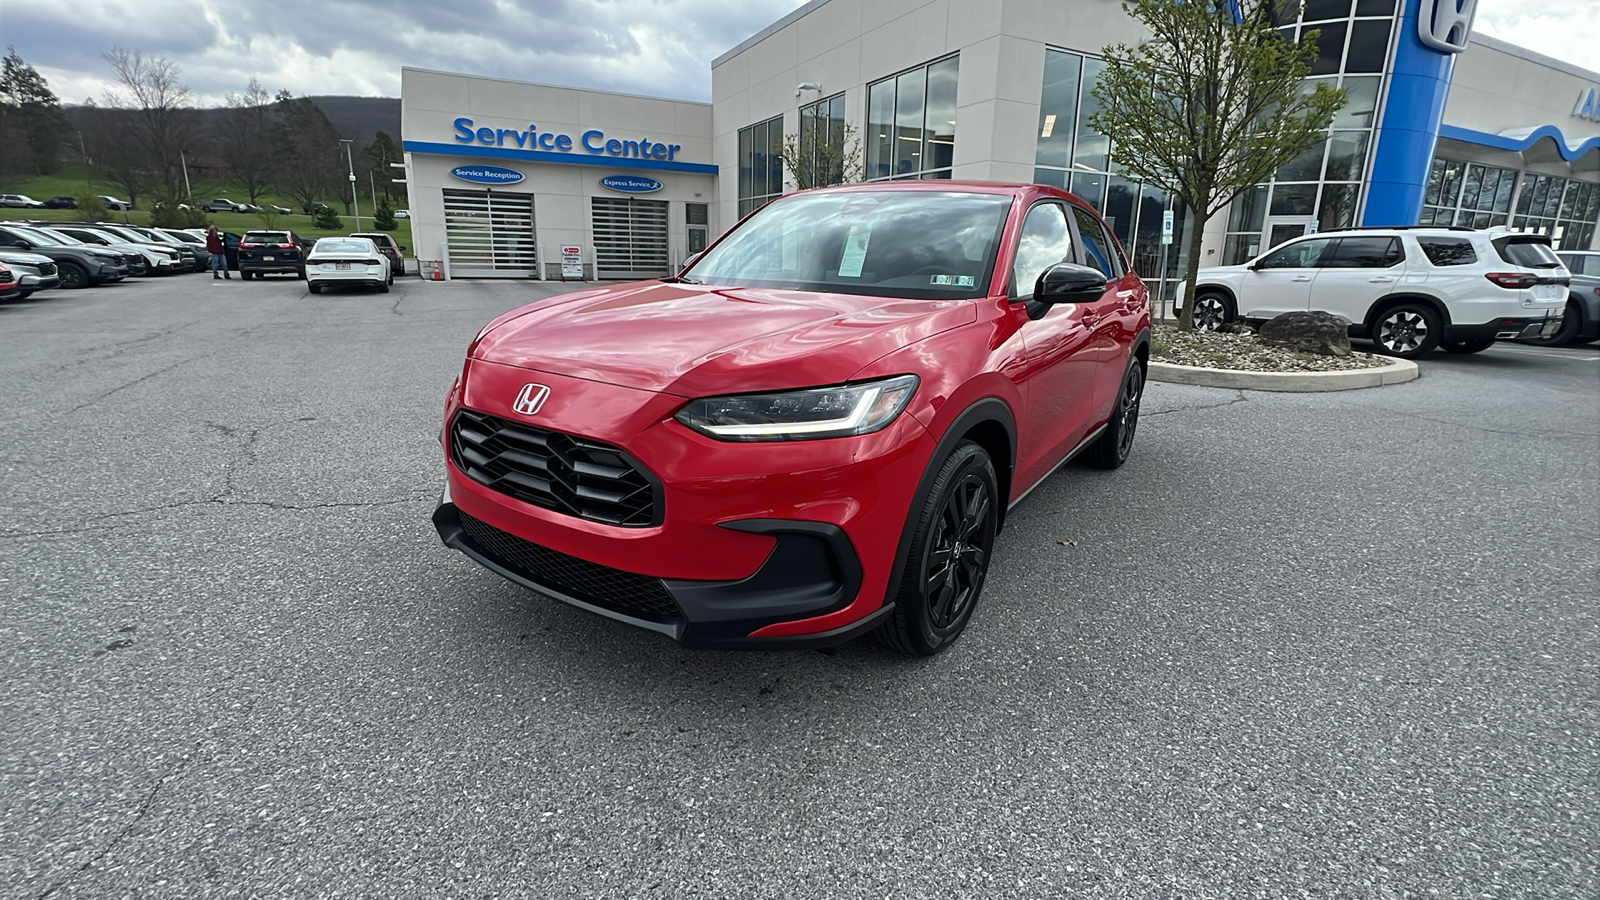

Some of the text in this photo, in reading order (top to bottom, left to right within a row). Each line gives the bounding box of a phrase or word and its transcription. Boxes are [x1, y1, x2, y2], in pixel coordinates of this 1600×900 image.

[453, 117, 681, 161] Service Center
[455, 168, 521, 180] Service Reception
[604, 179, 651, 188] Express Service
